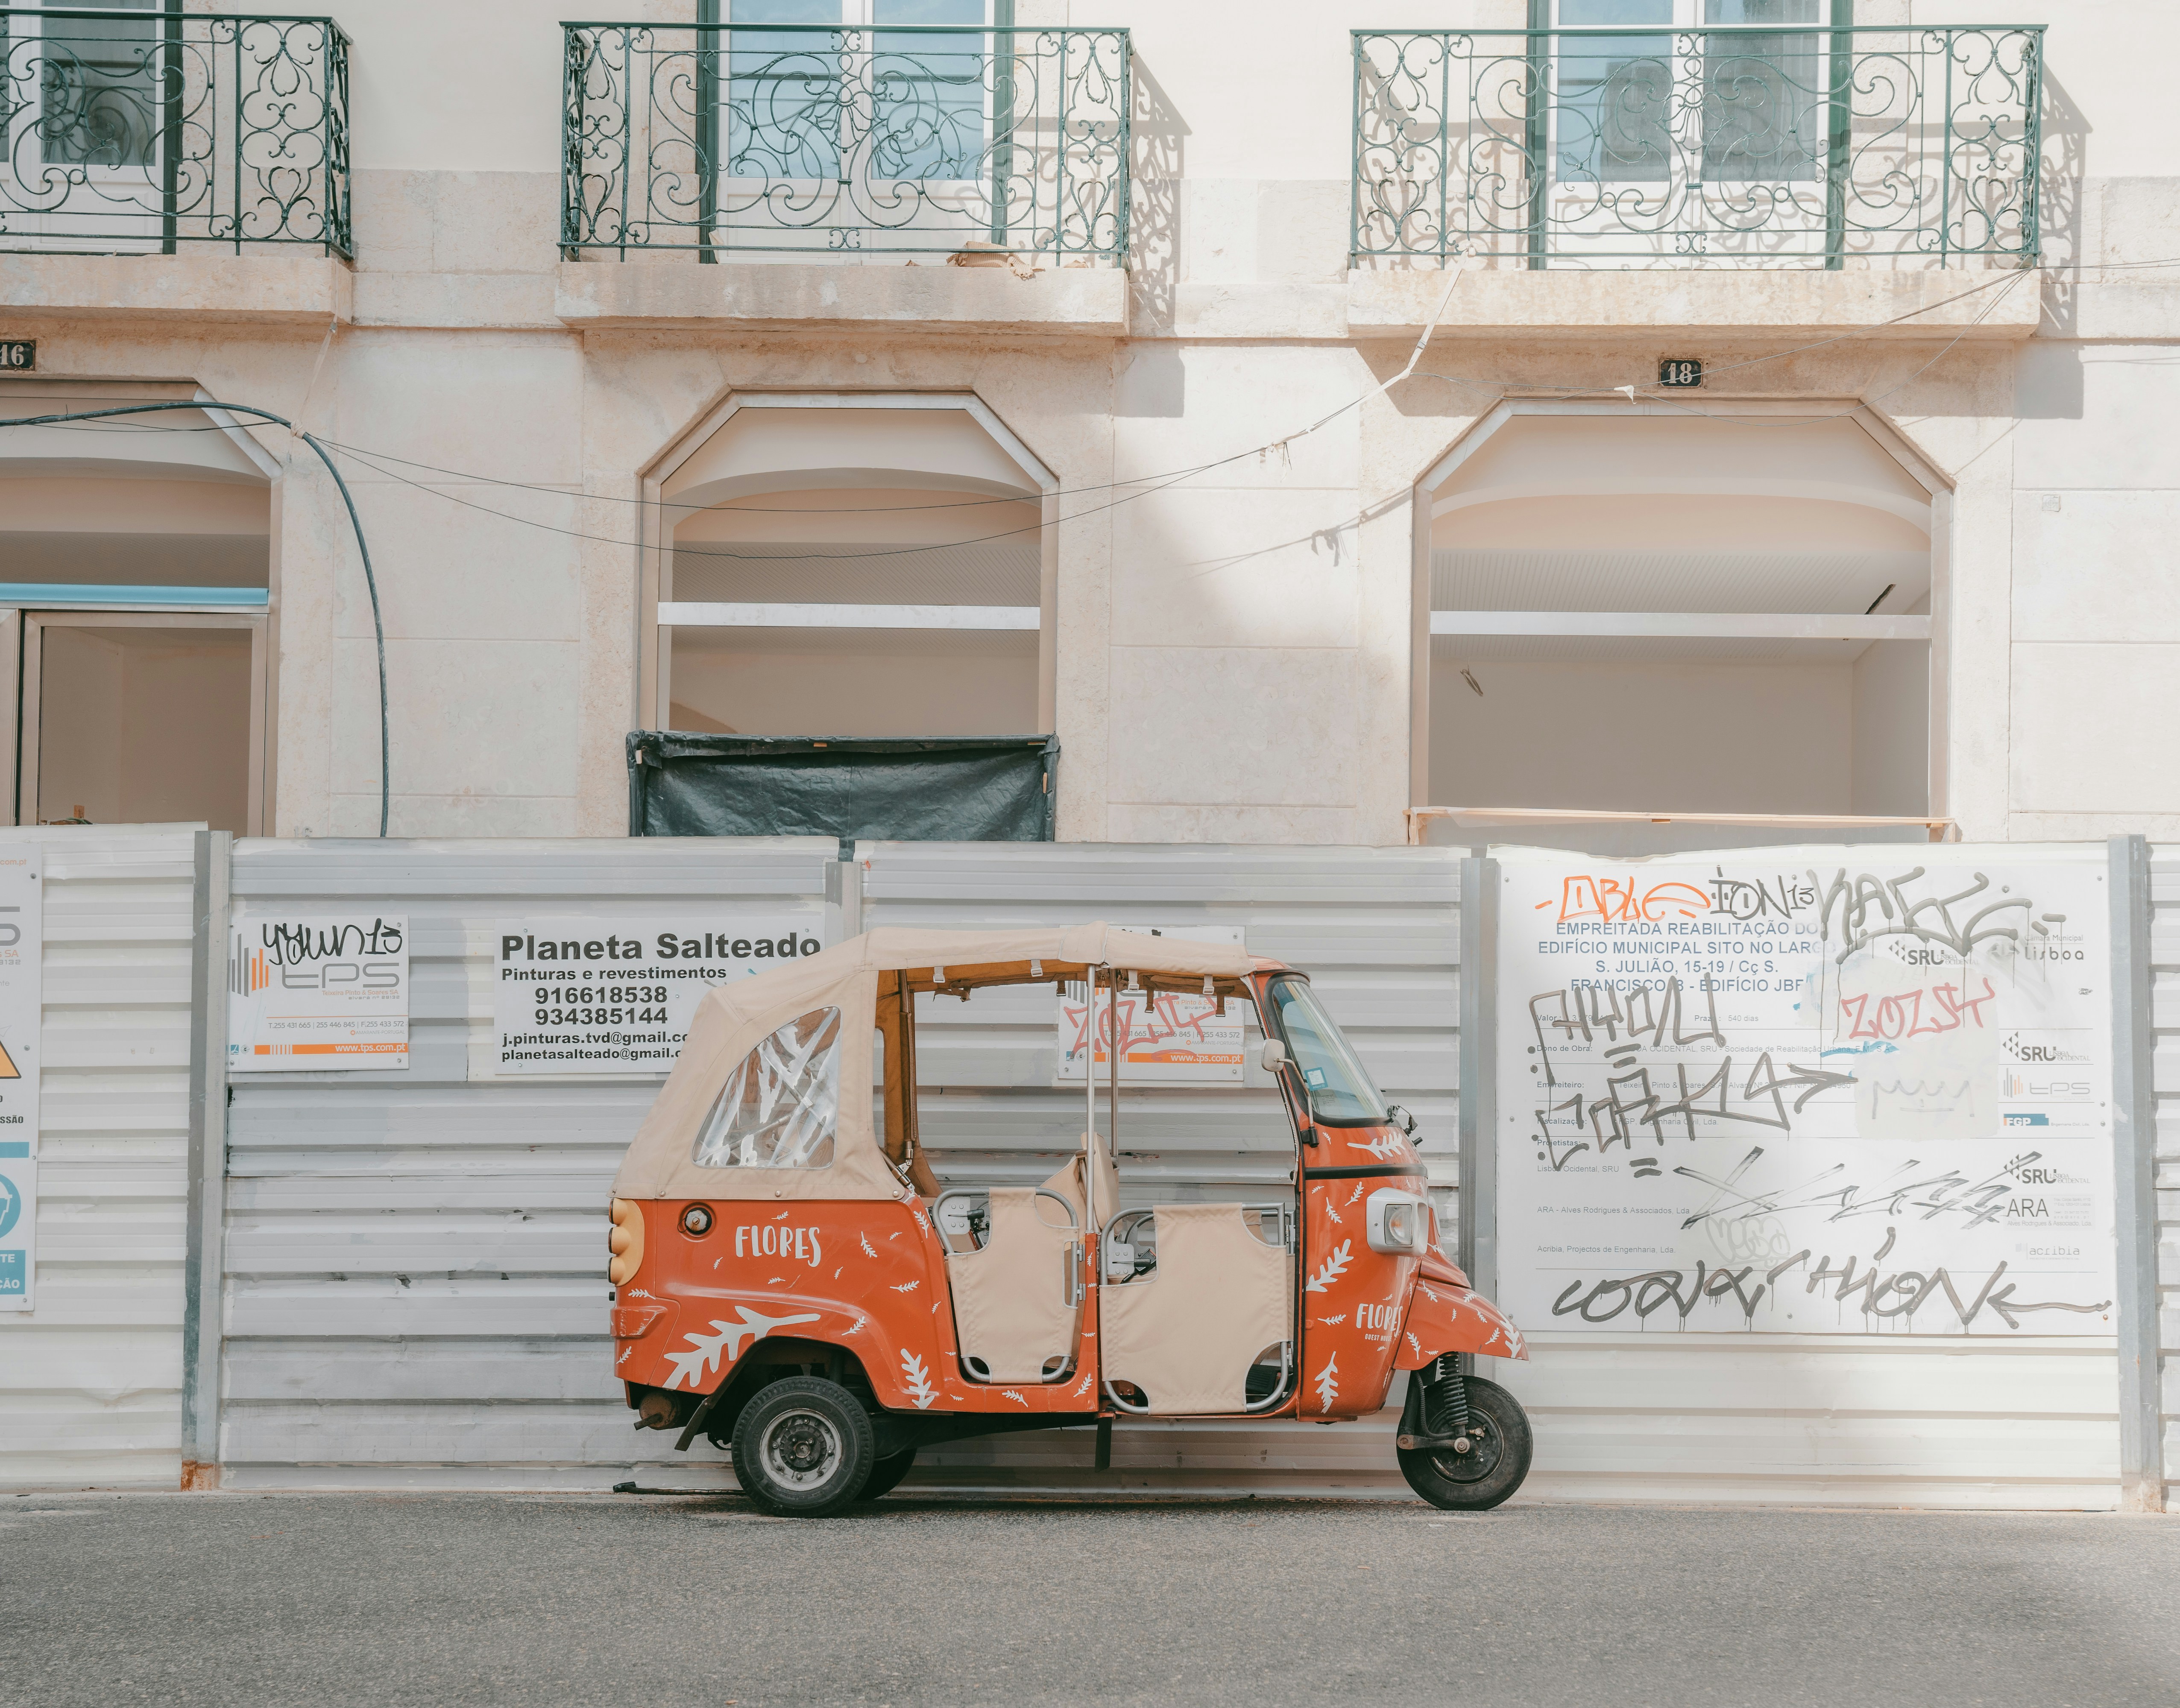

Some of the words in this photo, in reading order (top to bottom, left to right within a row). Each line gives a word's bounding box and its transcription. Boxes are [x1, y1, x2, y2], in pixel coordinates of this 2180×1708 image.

[0, 345, 24, 365] 16
[1668, 363, 1692, 383] 18
[1557, 923, 1661, 935] EMPREITADA
[1668, 920, 1788, 937] REABILITAÇÃO
[1796, 923, 1817, 934] DO
[2052, 934, 2083, 942] Municipal
[502, 934, 642, 960] Planeta
[656, 933, 821, 958] Salteado
[1539, 939, 1607, 954] EDIFÍCIO
[1614, 942, 1702, 954] MUNICIPAL
[1707, 942, 1743, 953] SITO
[1751, 942, 1772, 953] NO
[1908, 950, 1944, 965] SRU
[502, 968, 576, 981] Pinturas
[583, 971, 592, 980] e
[599, 967, 727, 979] revestimentos
[1596, 961, 1609, 973] S.
[1616, 958, 1678, 975] JULIÃO,
[1685, 961, 1723, 973] 15-19
[1729, 961, 1733, 973] /
[1739, 961, 1758, 975] Cç
[1764, 961, 1778, 973] S.
[1572, 979, 1665, 991] FRANCISCO
[1700, 977, 1768, 991] EDIFÍCIO
[535, 986, 667, 1004] 916618538
[535, 1007, 668, 1026] 934385144
[335, 1044, 405, 1053] www.tps.com.pt
[1777, 1046, 1821, 1054] Reabilitação
[2022, 1046, 2056, 1061] SRU
[1171, 1054, 1241, 1065] www.tps.com.pt
[2007, 1117, 2031, 1126] FGP
[2022, 1169, 2057, 1184] SRU
[2007, 1199, 2049, 1217] ARA
[735, 1225, 821, 1267] FLORES
[1567, 1246, 1600, 1254] Projectos
[2030, 1246, 2080, 1255] acribia
[1356, 1303, 1403, 1337] FLORES
